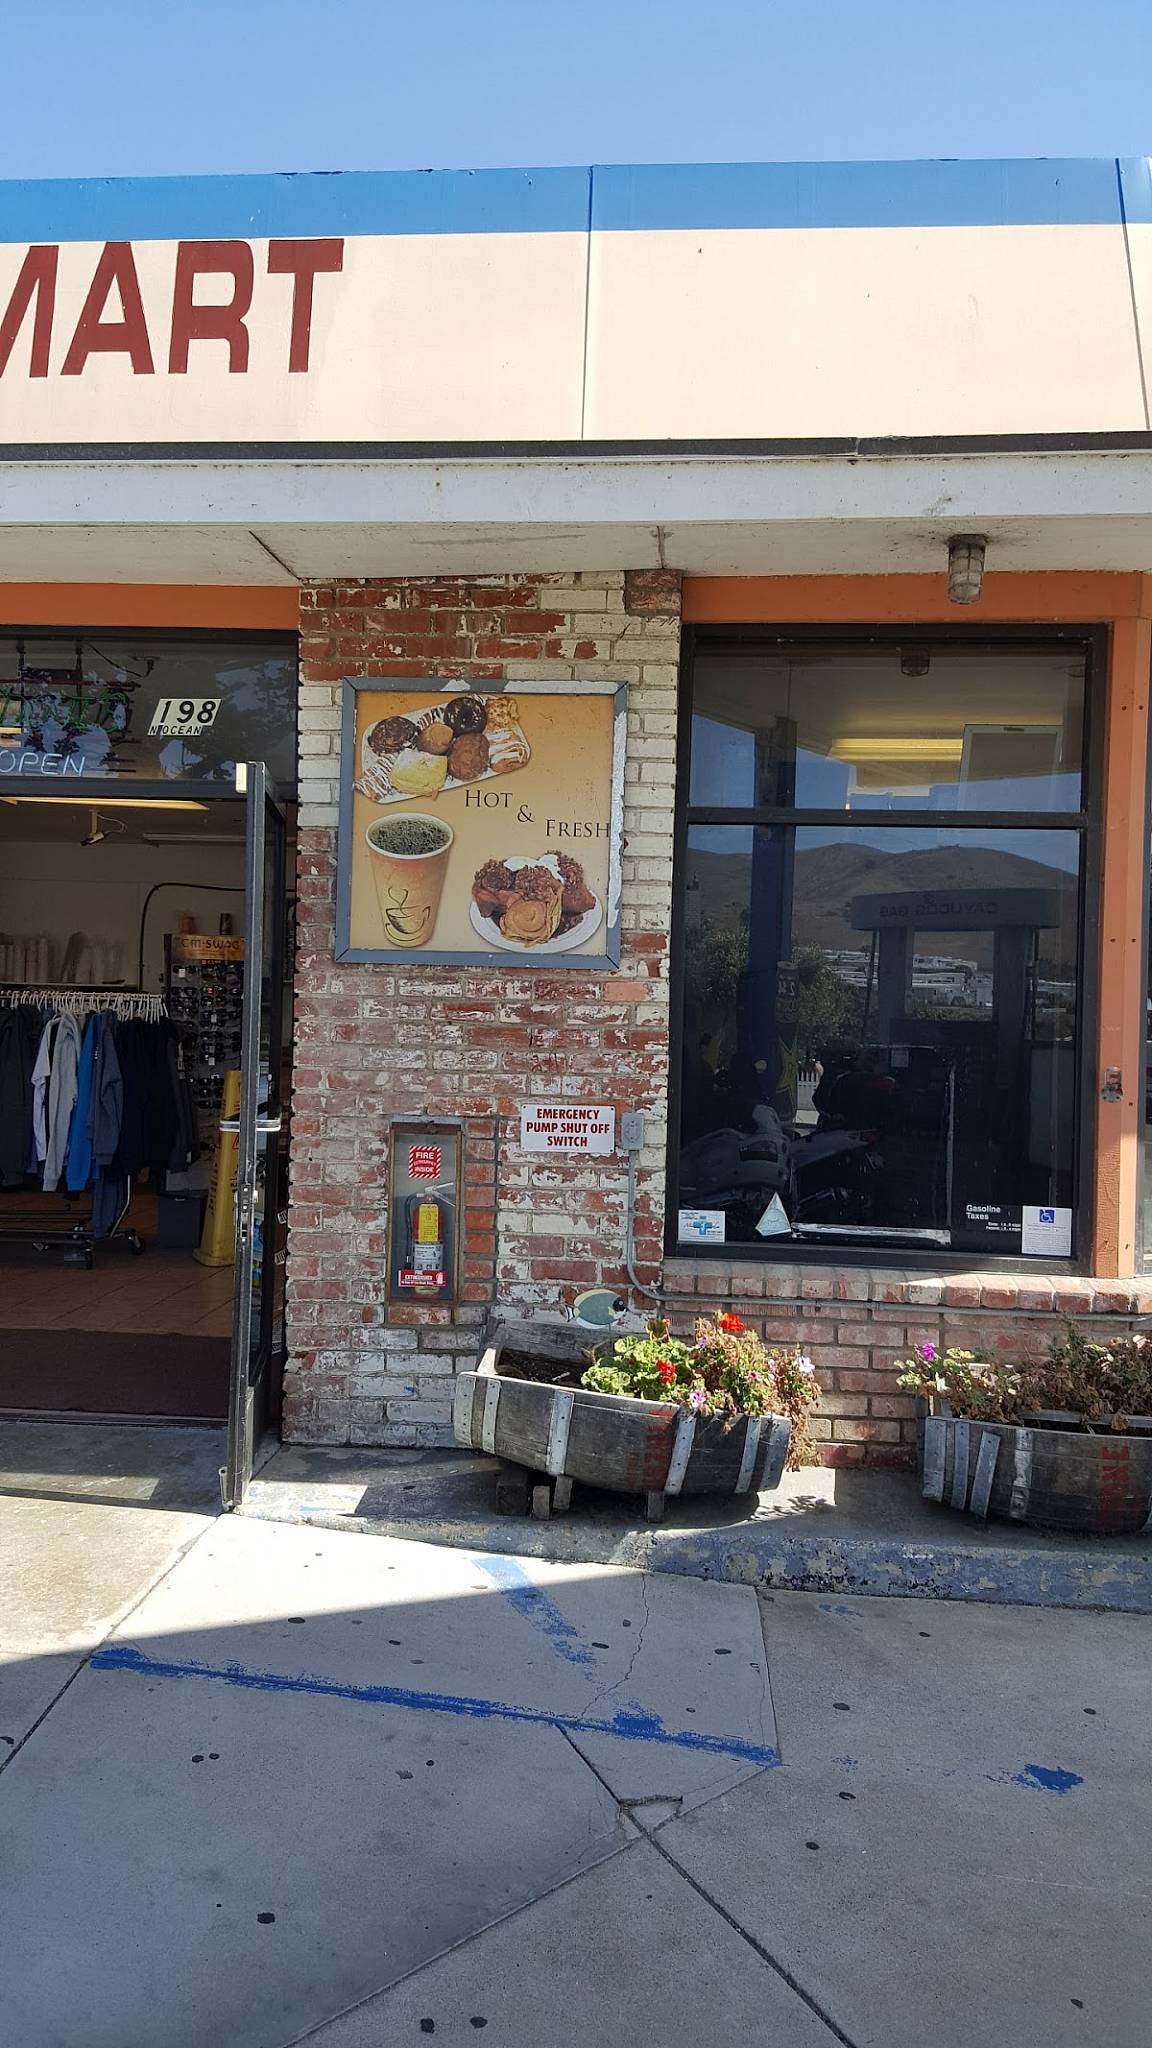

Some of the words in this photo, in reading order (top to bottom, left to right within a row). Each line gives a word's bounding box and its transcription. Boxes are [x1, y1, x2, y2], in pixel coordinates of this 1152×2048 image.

[160, 700, 216, 723] 198
[150, 725, 157, 734] N
[162, 725, 201, 735] OCEAN
[0, 749, 86, 777] OPEN
[465, 790, 513, 808] HOT
[517, 804, 535, 823] &
[546, 819, 611, 838] FRESH
[537, 1108, 600, 1120] EMERGENCY
[526, 1122, 558, 1133] PUMP
[560, 1123, 588, 1134] SHUT
[590, 1123, 610, 1134] OFF
[547, 1136, 588, 1147] SWITCH
[415, 1151, 435, 1160] FIRE
[966, 1204, 1001, 1214] Gasoline
[966, 1212, 989, 1220] Taxes
